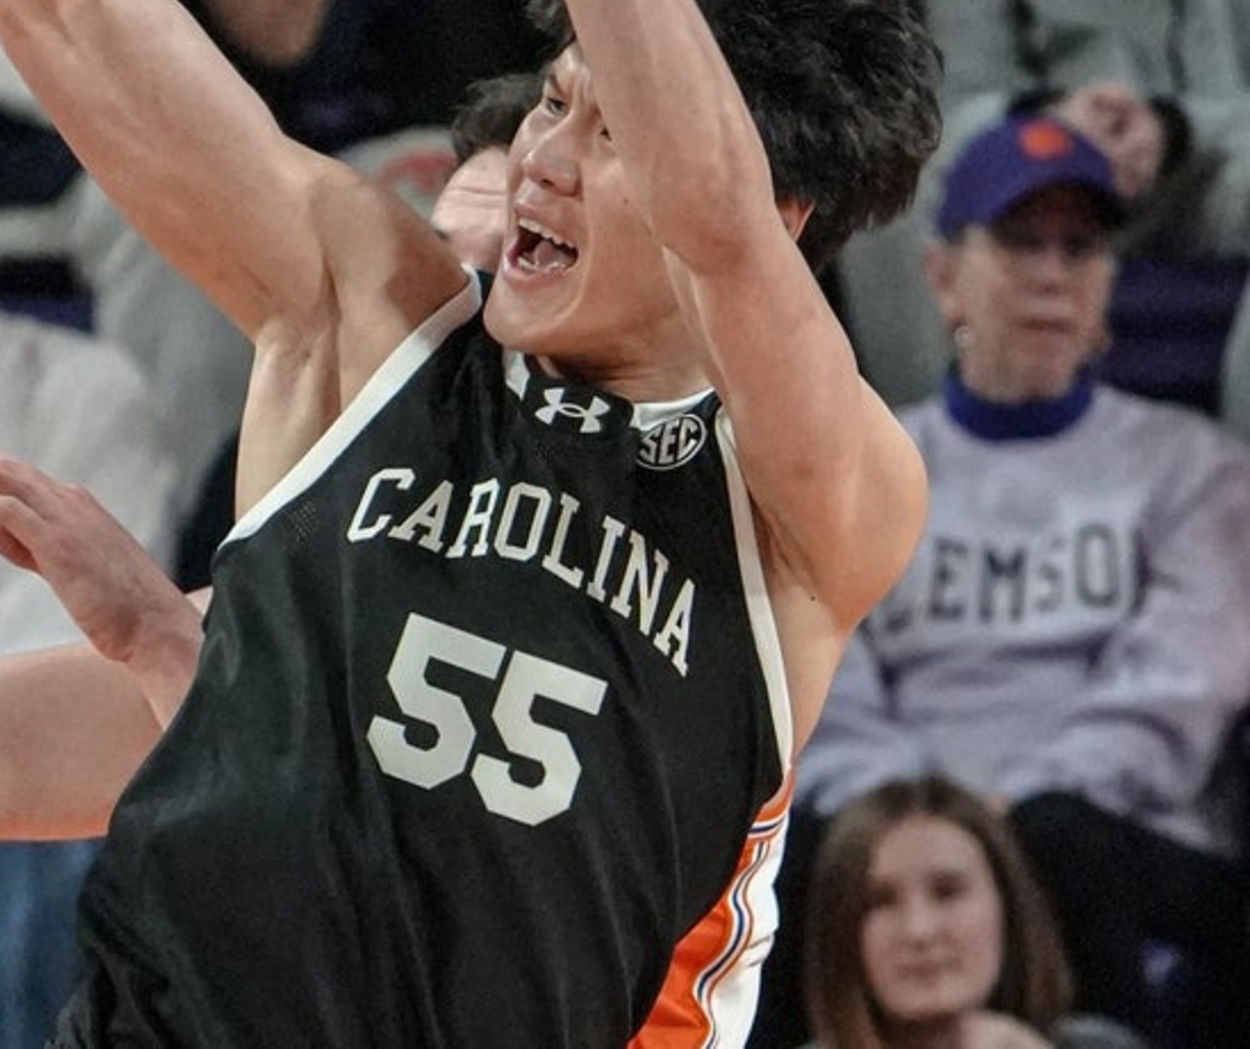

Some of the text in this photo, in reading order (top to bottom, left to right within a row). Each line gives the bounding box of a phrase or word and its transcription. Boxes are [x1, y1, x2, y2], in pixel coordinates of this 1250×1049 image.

[639, 417, 699, 464] SEC
[346, 467, 697, 678] CAROLINA
[366, 611, 609, 827] 55
